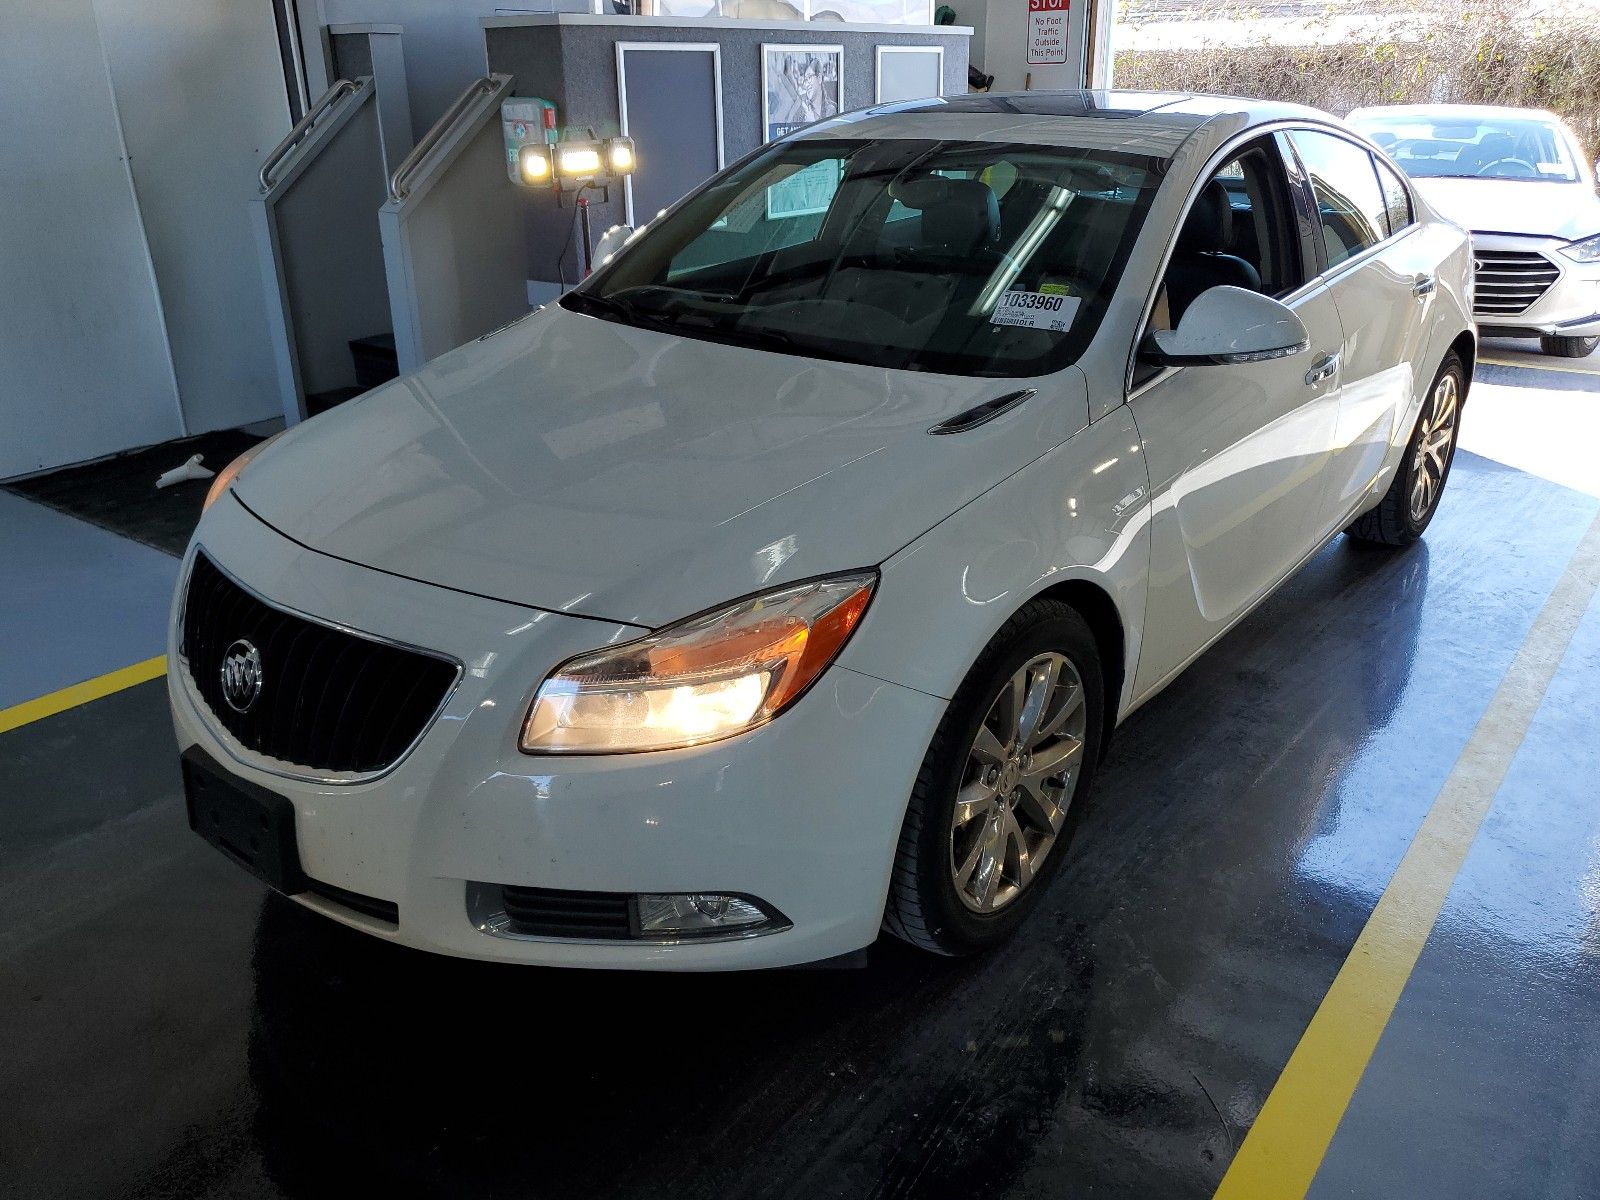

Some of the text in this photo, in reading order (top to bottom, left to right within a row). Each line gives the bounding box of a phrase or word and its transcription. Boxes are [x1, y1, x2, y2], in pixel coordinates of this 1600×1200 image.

[1038, 28, 1059, 36] Traffic
[1035, 38, 1060, 46] Outside
[1031, 48, 1064, 57] This Point
[776, 127, 789, 136] GET
[1004, 293, 1064, 312] 1033960
